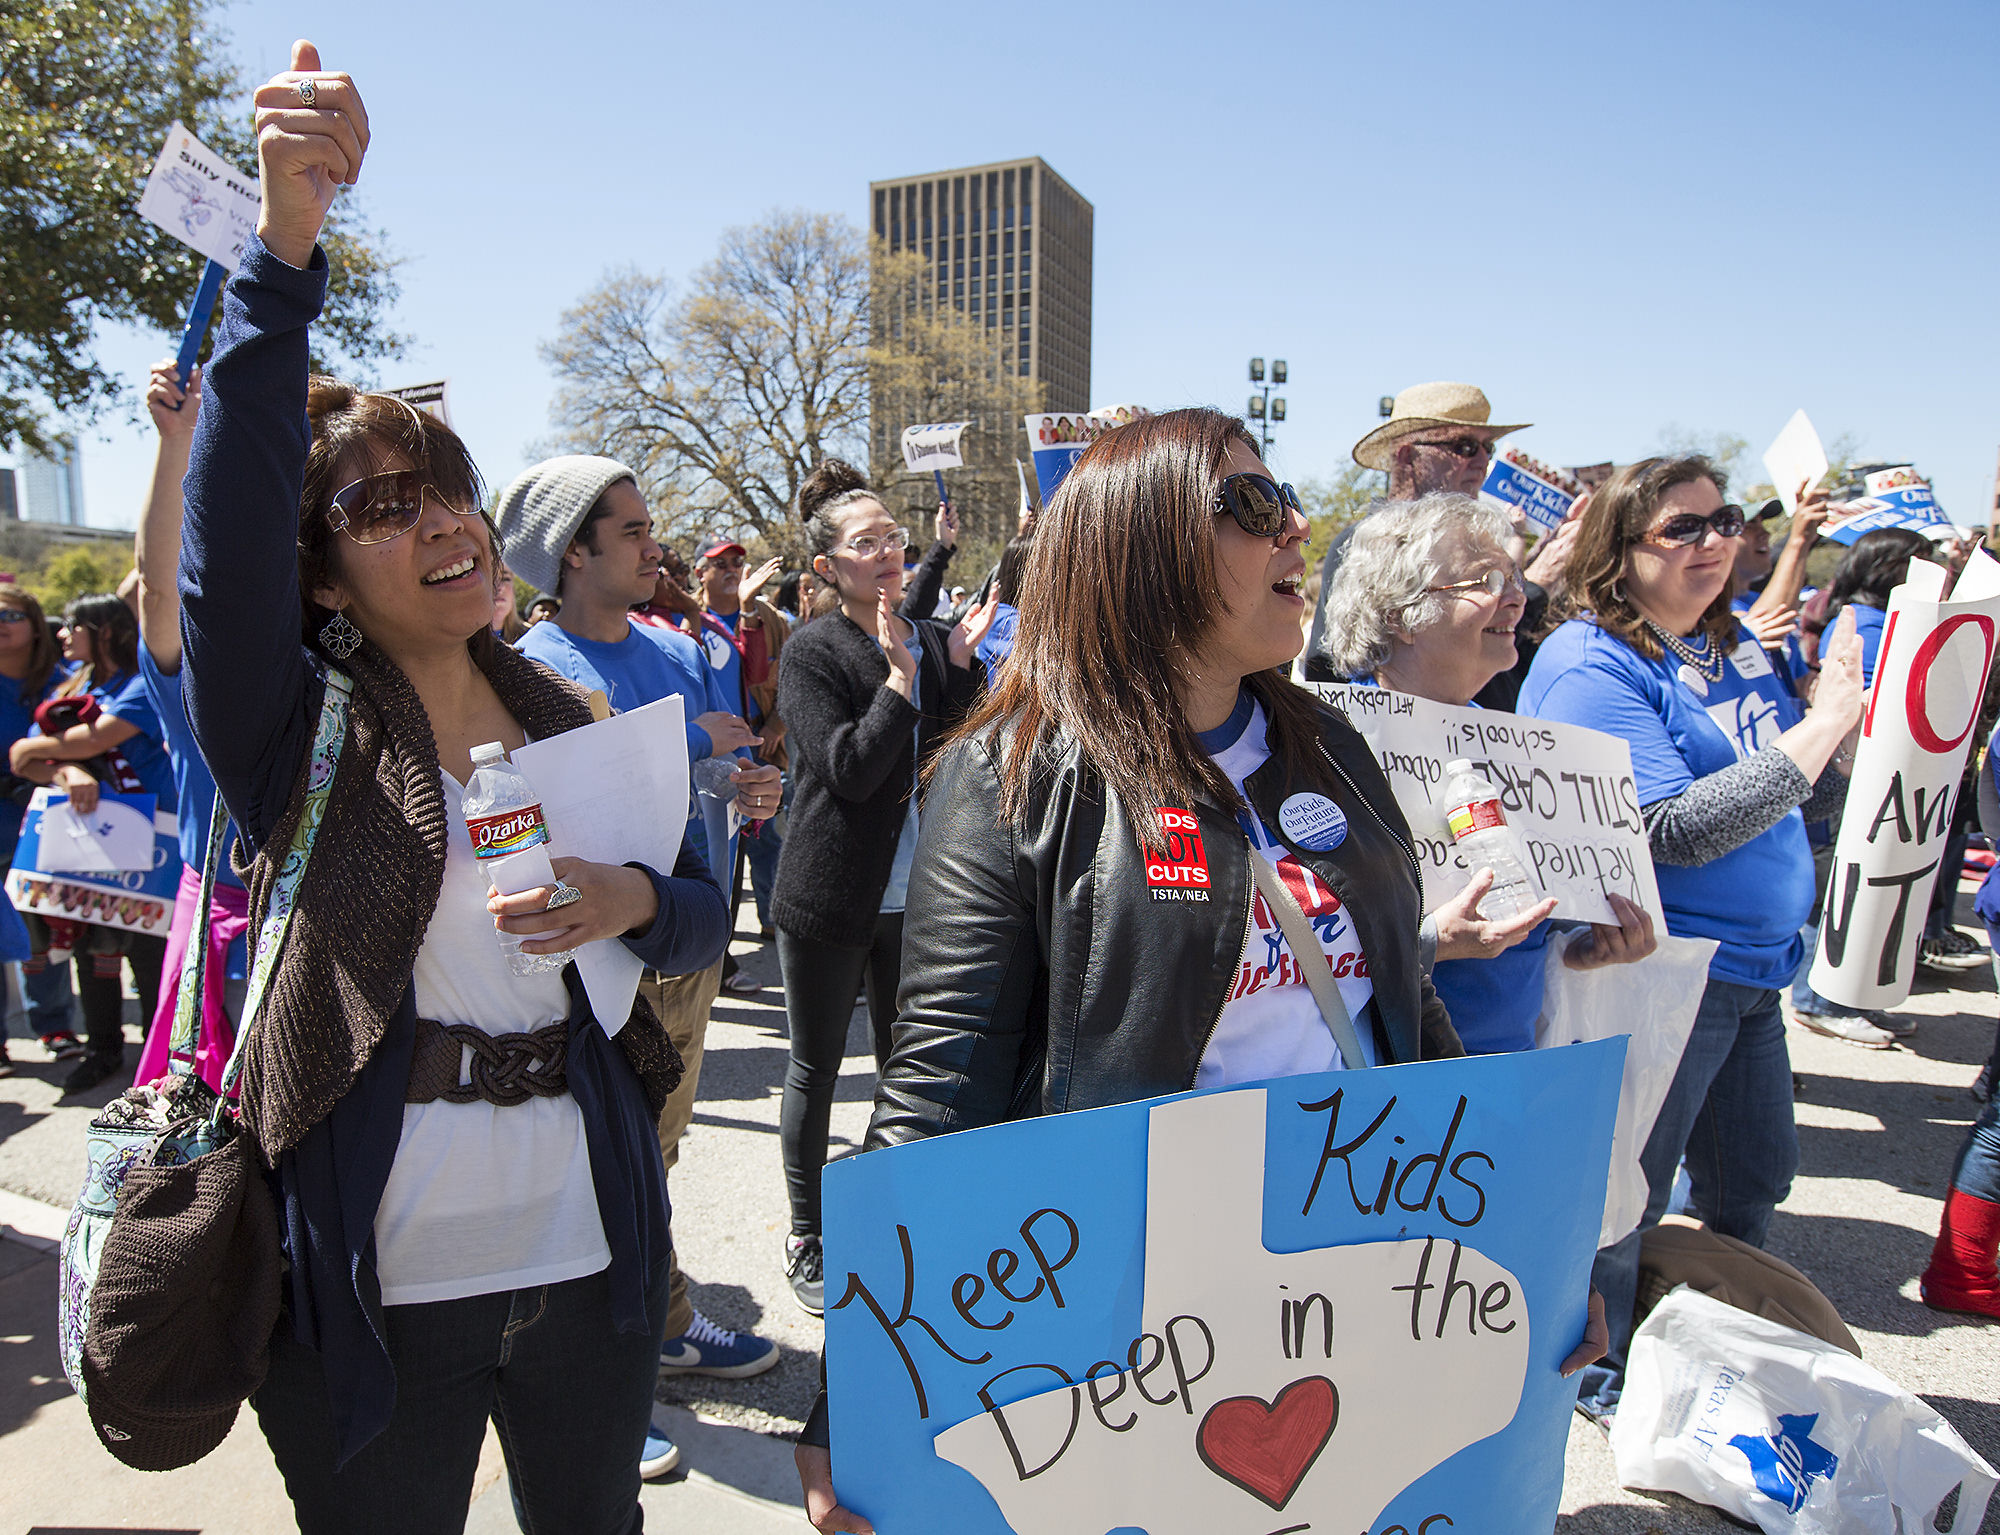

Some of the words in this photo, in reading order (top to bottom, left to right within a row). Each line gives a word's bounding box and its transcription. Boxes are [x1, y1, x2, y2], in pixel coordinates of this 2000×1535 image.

[179, 151, 219, 181] Silly
[1317, 684, 1349, 714] Day
[1349, 687, 1392, 715] Lobby
[1393, 696, 1415, 717] AFT
[1561, 771, 1642, 836] STILL
[479, 813, 535, 846] Ozarka
[1157, 813, 1198, 830] IDS
[1147, 864, 1208, 883] CUTS
[1526, 837, 1645, 909] Retired
[1151, 888, 1210, 902] TSTA/NEA
[831, 1207, 1080, 1420] Keep
[1296, 1086, 1495, 1227] Kids
[977, 1314, 1216, 1481] Deep
[1277, 1283, 1334, 1360] in
[1390, 1234, 1516, 1342] the
[1704, 1365, 1746, 1418] Texas
